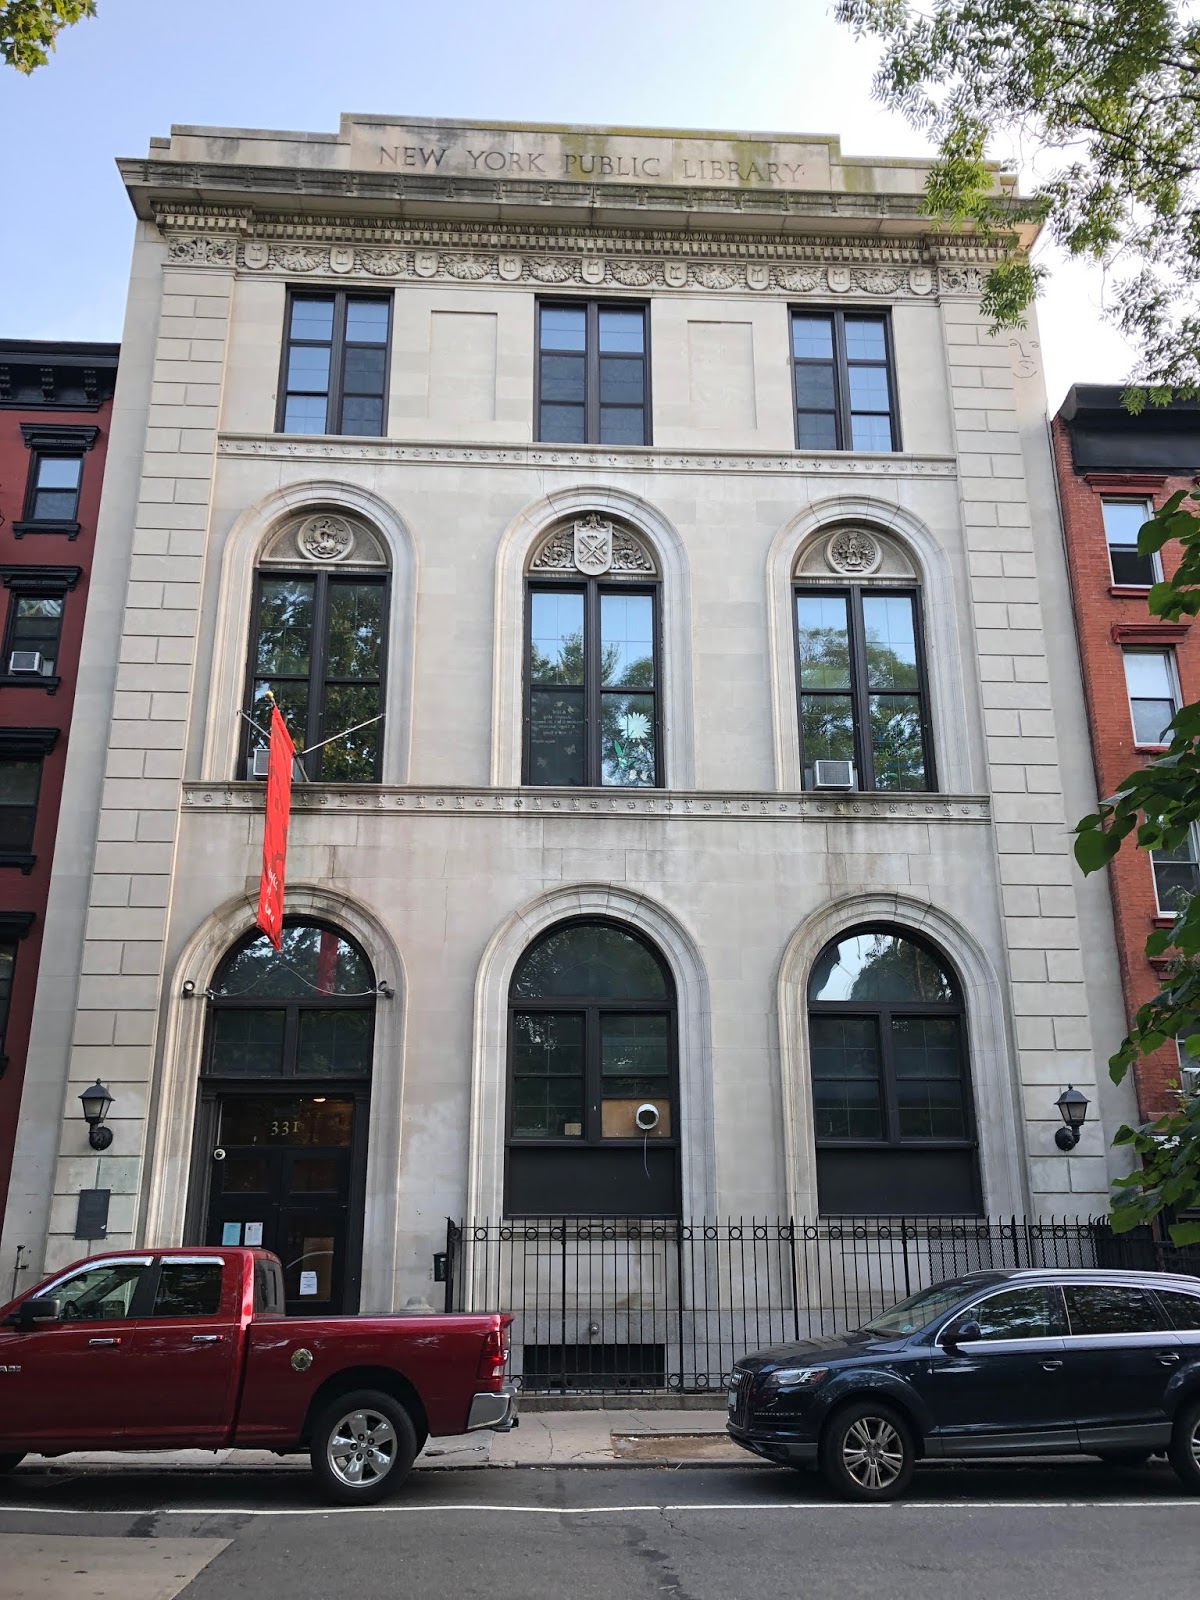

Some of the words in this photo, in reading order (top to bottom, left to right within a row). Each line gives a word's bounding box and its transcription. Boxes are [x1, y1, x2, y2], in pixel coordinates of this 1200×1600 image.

[379, 145, 448, 168] NEW
[466, 149, 546, 173] YORK
[564, 154, 660, 178] PUBLIC
[683, 159, 804, 184] LIBRARY
[271, 1121, 299, 1136] 331
